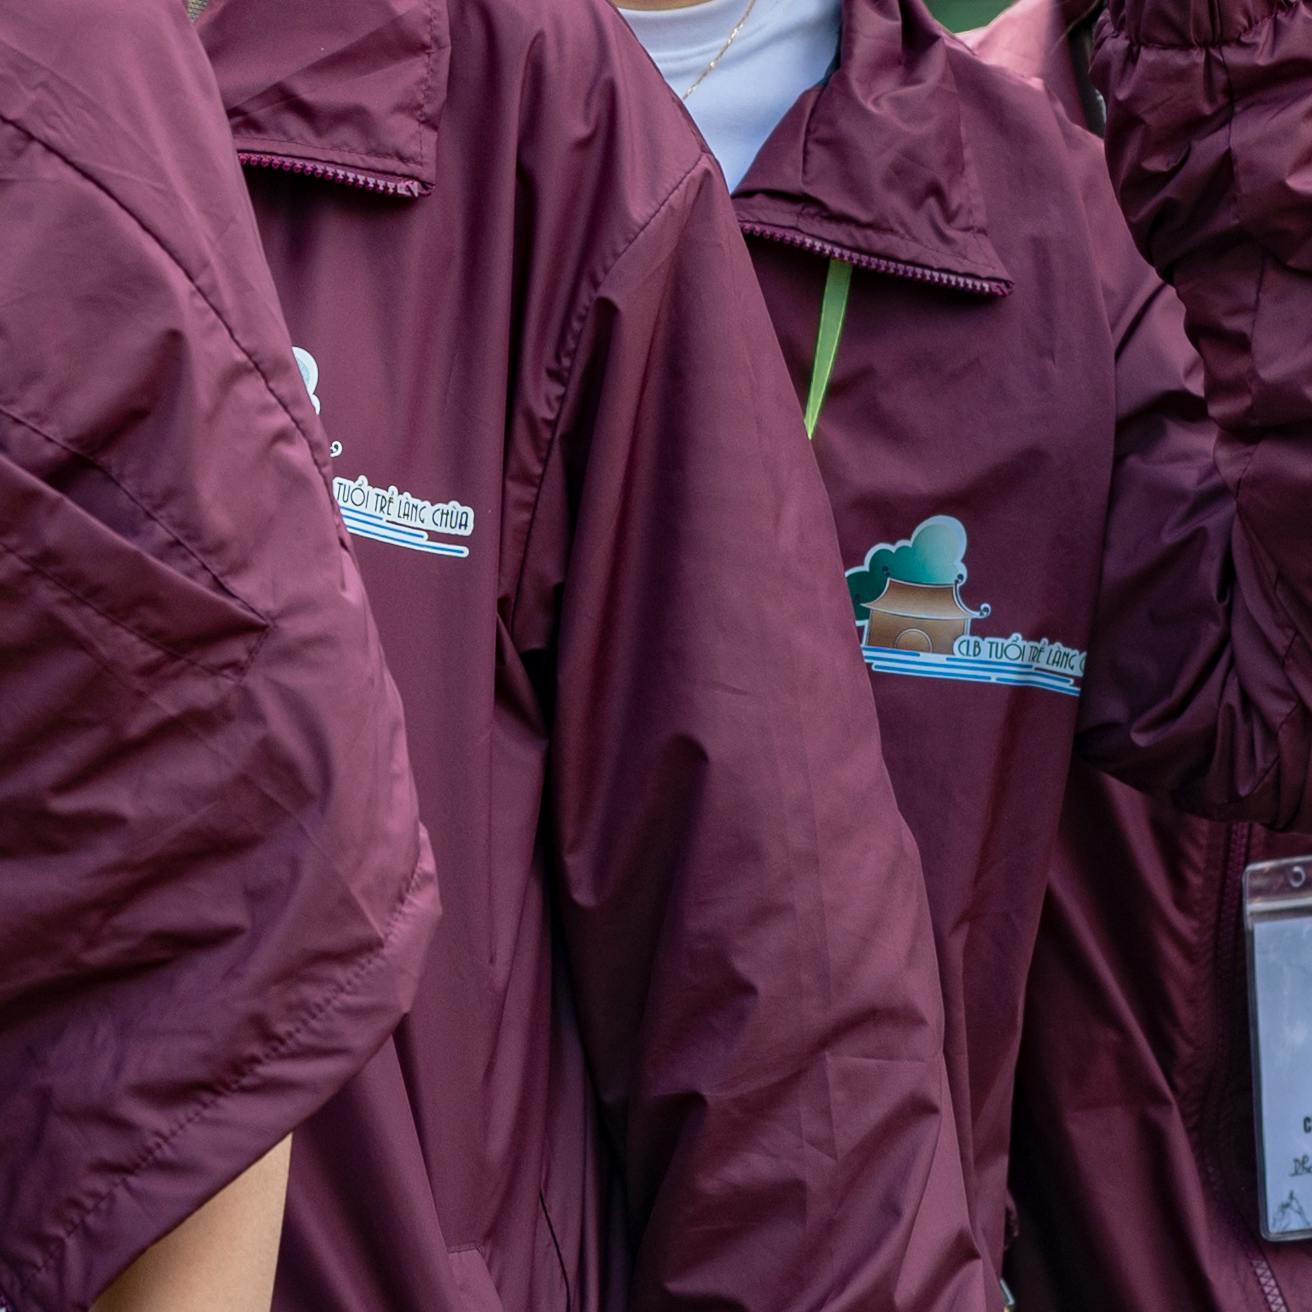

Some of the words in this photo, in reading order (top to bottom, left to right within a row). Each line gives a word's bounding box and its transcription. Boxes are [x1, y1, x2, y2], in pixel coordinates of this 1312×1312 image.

[336, 480, 370, 509] TUỔI
[374, 490, 394, 516] TRẺ
[431, 505, 469, 530] CHÙA
[957, 639, 982, 657] CLB
[987, 635, 1026, 661] TUỔI
[1028, 640, 1046, 664] TRẺ
